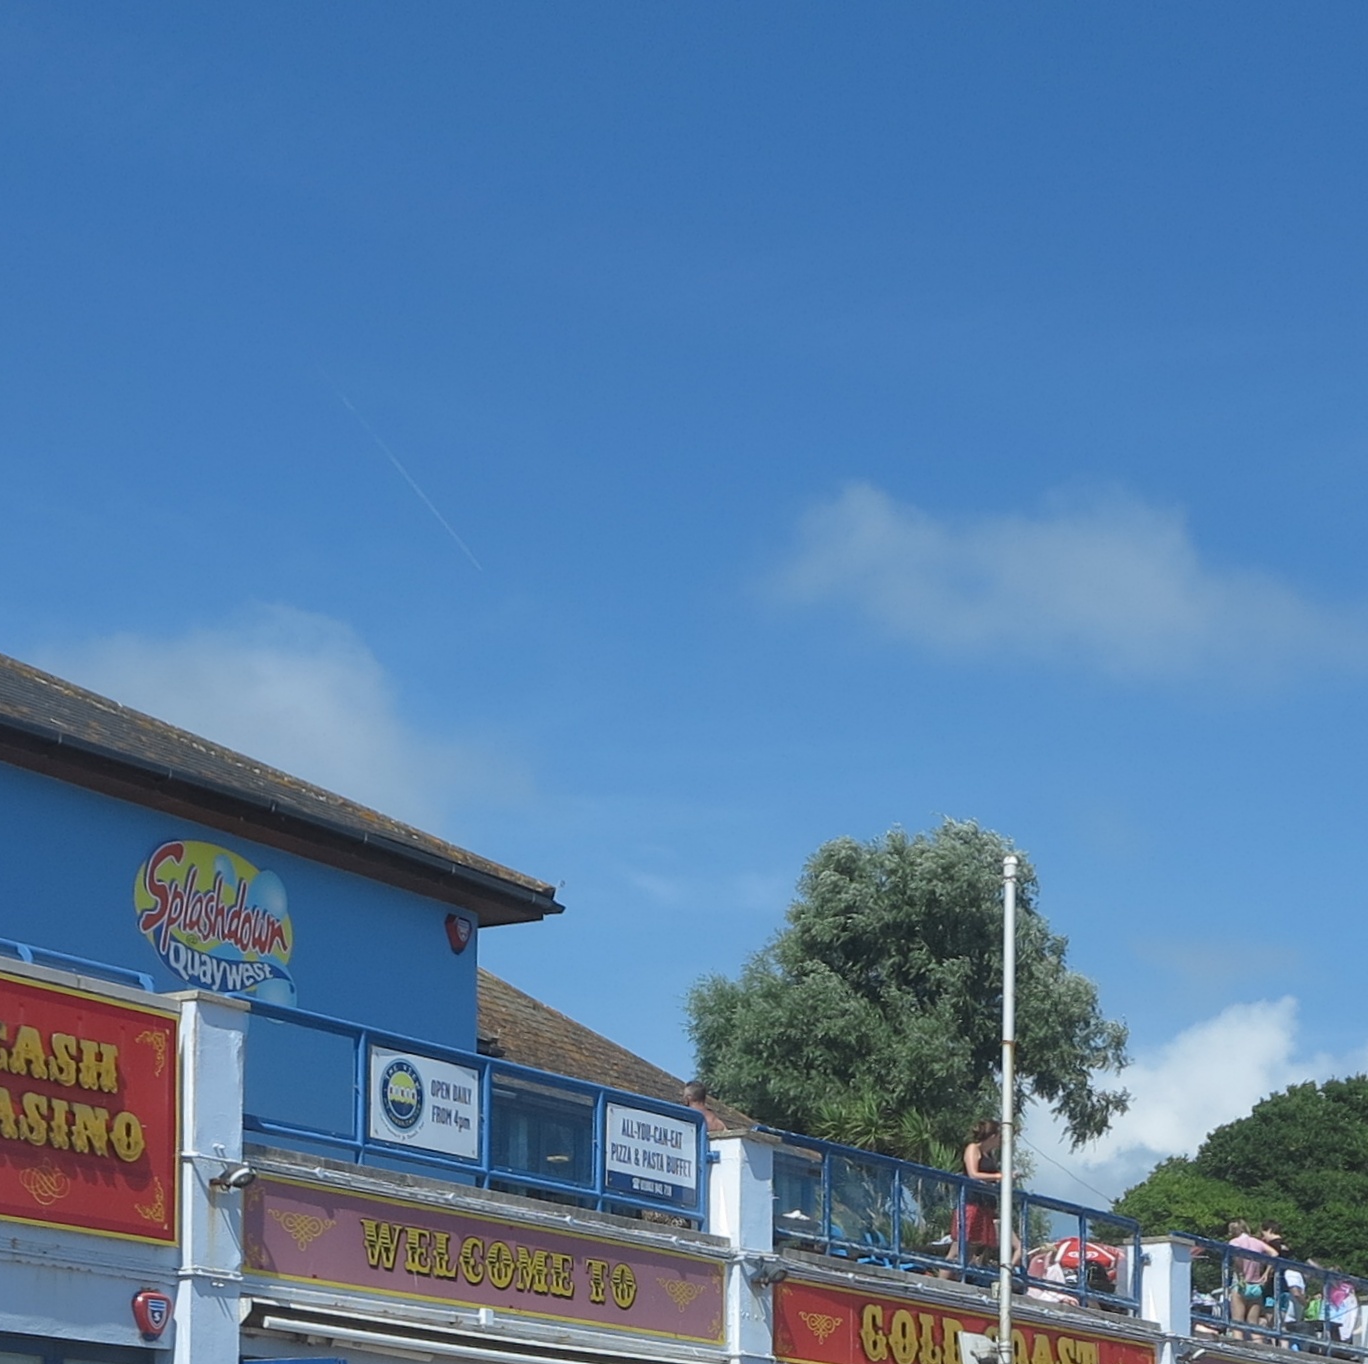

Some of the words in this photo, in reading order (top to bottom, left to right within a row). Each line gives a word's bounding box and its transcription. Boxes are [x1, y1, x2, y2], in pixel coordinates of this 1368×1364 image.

[139, 841, 289, 955] Splashdown
[431, 1079, 450, 1100] OPEN
[452, 1084, 472, 1105] DAILY
[432, 1105, 452, 1126] FROM
[454, 1110, 471, 1132] 4pm
[621, 1118, 683, 1150] ALL-YOU-CAN-EAT
[611, 1142, 632, 1164] PIZZA
[634, 1148, 640, 1166] &
[642, 1149, 664, 1172] PASTA
[666, 1154, 692, 1178] BUFFET
[361, 1219, 574, 1298] WELCOME
[585, 1258, 637, 1309] TO
